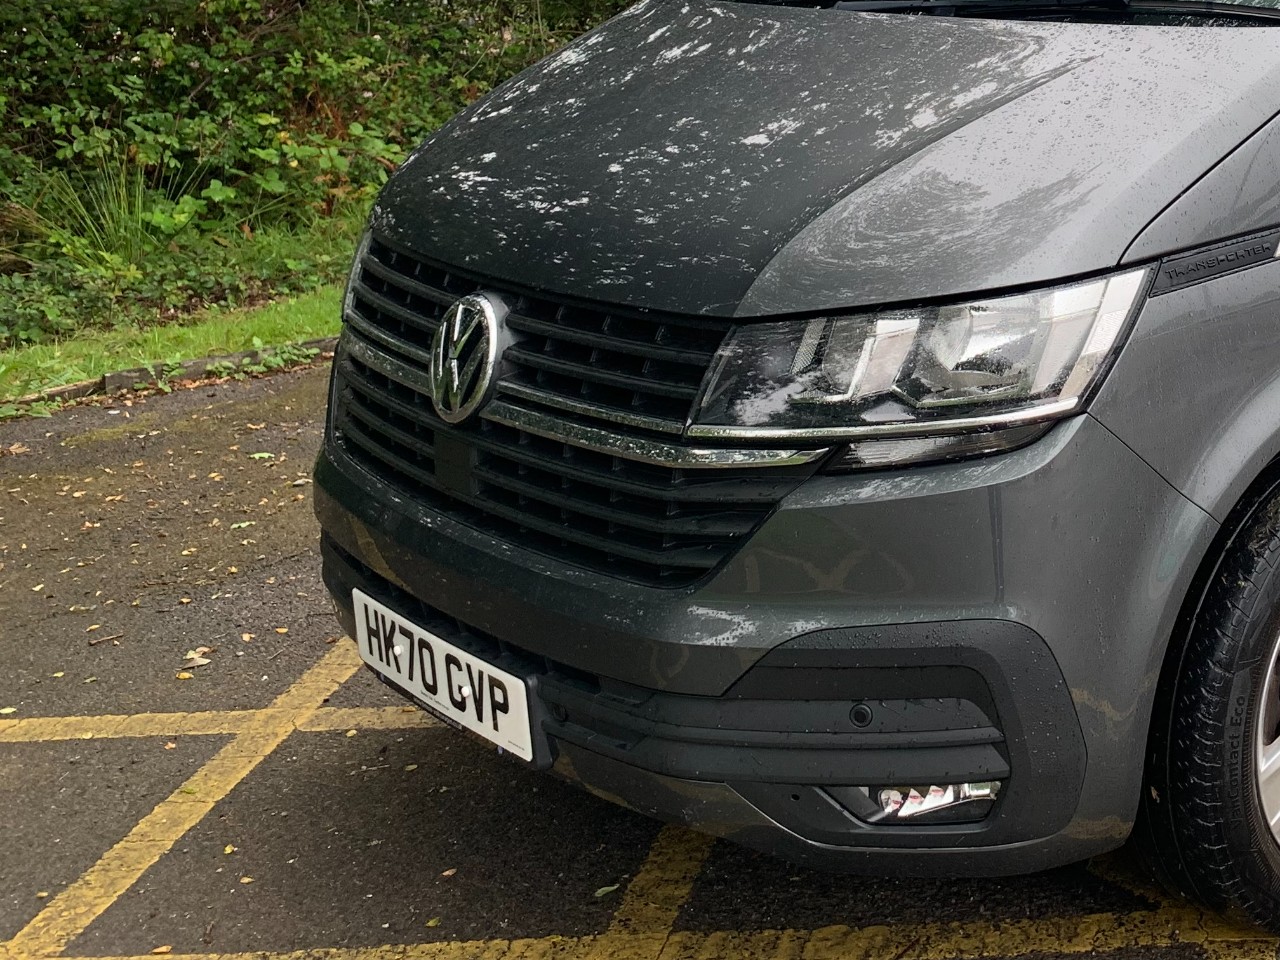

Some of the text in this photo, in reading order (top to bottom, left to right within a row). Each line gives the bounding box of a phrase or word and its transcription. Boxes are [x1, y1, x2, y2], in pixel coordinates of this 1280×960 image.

[1165, 245, 1272, 279] TRANSPORTER
[364, 603, 509, 732] HK70 GVP
[1230, 696, 1246, 727] Eco
